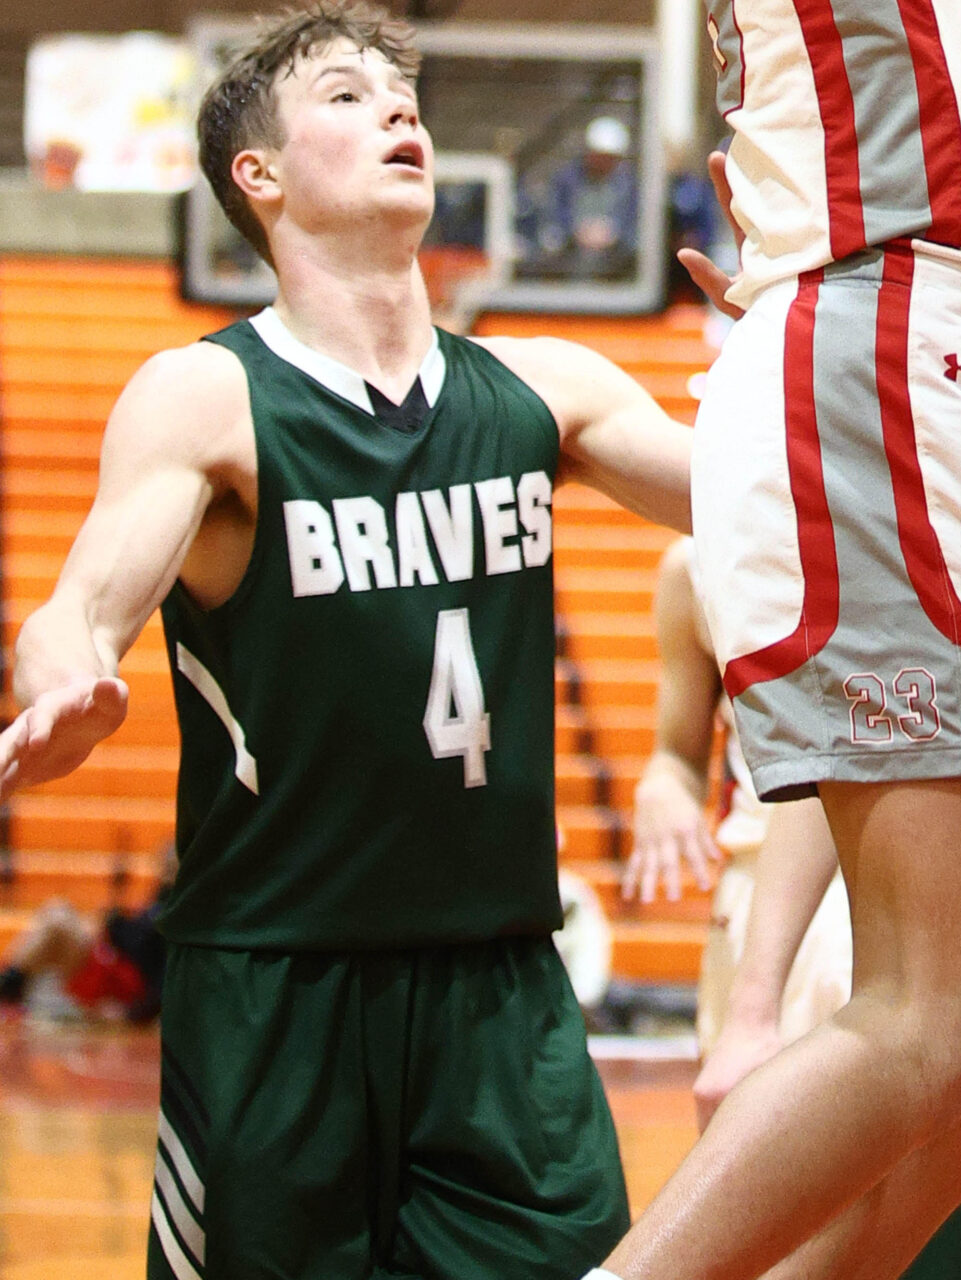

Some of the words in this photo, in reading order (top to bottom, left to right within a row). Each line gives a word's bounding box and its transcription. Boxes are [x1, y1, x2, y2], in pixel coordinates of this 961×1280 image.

[283, 470, 553, 598] BRAVES
[423, 608, 491, 789] 4
[842, 667, 941, 745] 23
